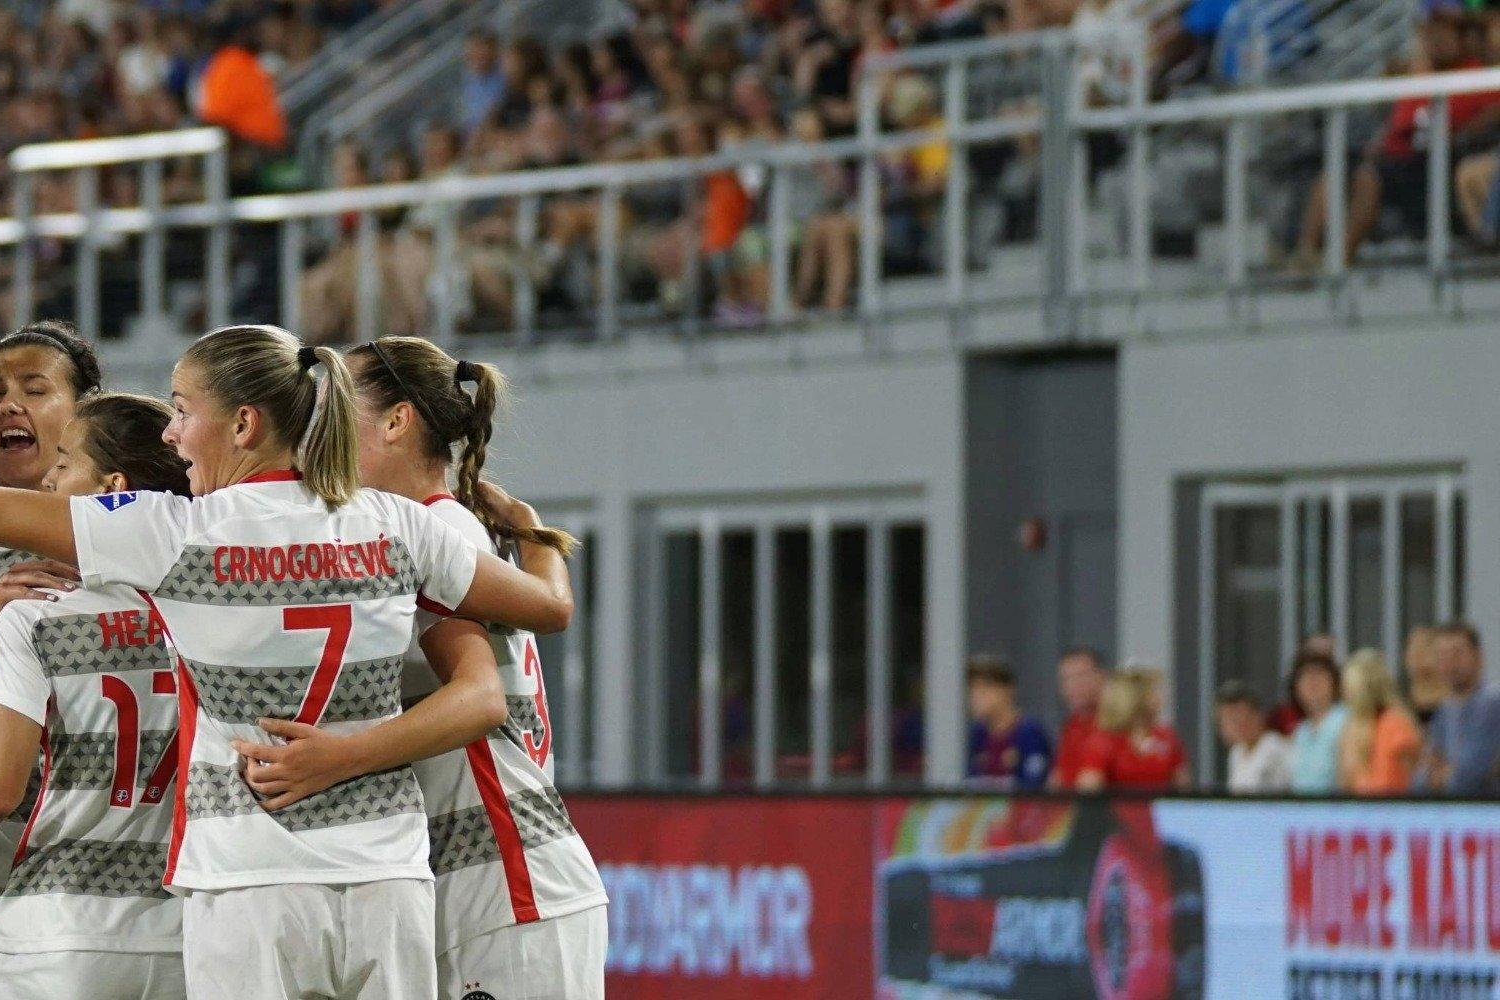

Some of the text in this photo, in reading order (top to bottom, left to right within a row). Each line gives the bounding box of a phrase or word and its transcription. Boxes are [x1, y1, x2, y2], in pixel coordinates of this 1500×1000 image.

[282, 603, 353, 728] 7
[102, 673, 180, 809] 17
[1286, 826, 1395, 949] MORE
